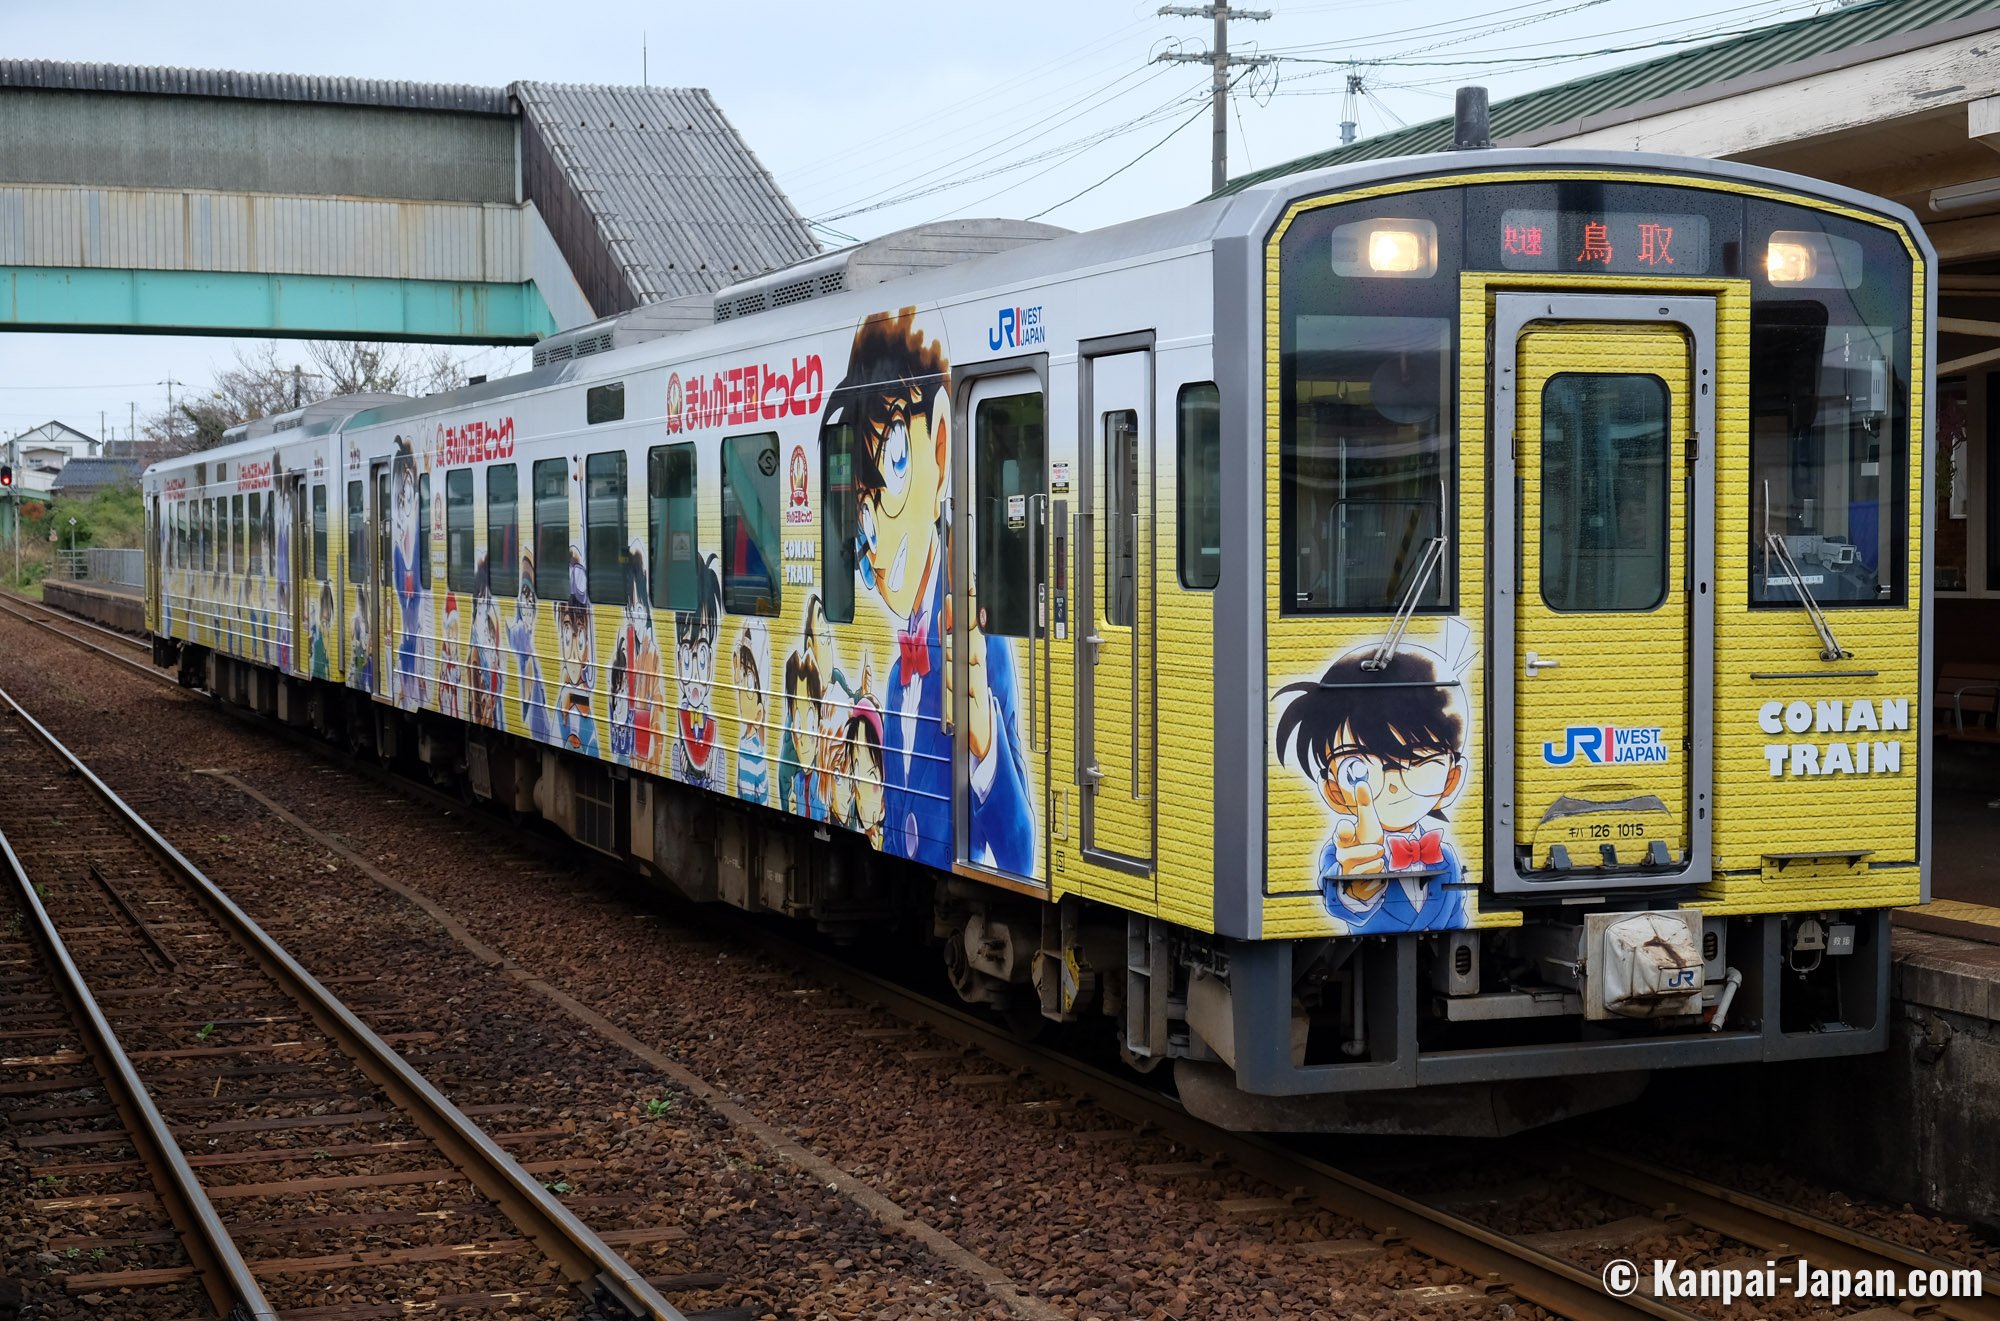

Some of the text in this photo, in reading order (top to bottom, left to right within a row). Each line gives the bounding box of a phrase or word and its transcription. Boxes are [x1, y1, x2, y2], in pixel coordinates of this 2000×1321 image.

[1577, 221, 1675, 265] 鳥取
[1020, 306, 1043, 326] WEST
[989, 307, 1016, 351] JR
[1020, 325, 1046, 346] JAPAN
[685, 354, 824, 431] まんが王国とっとり
[446, 416, 514, 466] まんが王国とっとり
[784, 538, 816, 560] CONAN
[785, 564, 815, 585] TRAIN
[1757, 698, 1909, 735] CONAN
[1543, 727, 1602, 765] JR
[1614, 728, 1661, 745] WEST
[1614, 746, 1667, 763] JAPAN
[1764, 740, 1901, 777] TRAIN
[1589, 824, 1610, 838] 126
[1617, 823, 1644, 837] 1015
[1668, 970, 1695, 988] JR
